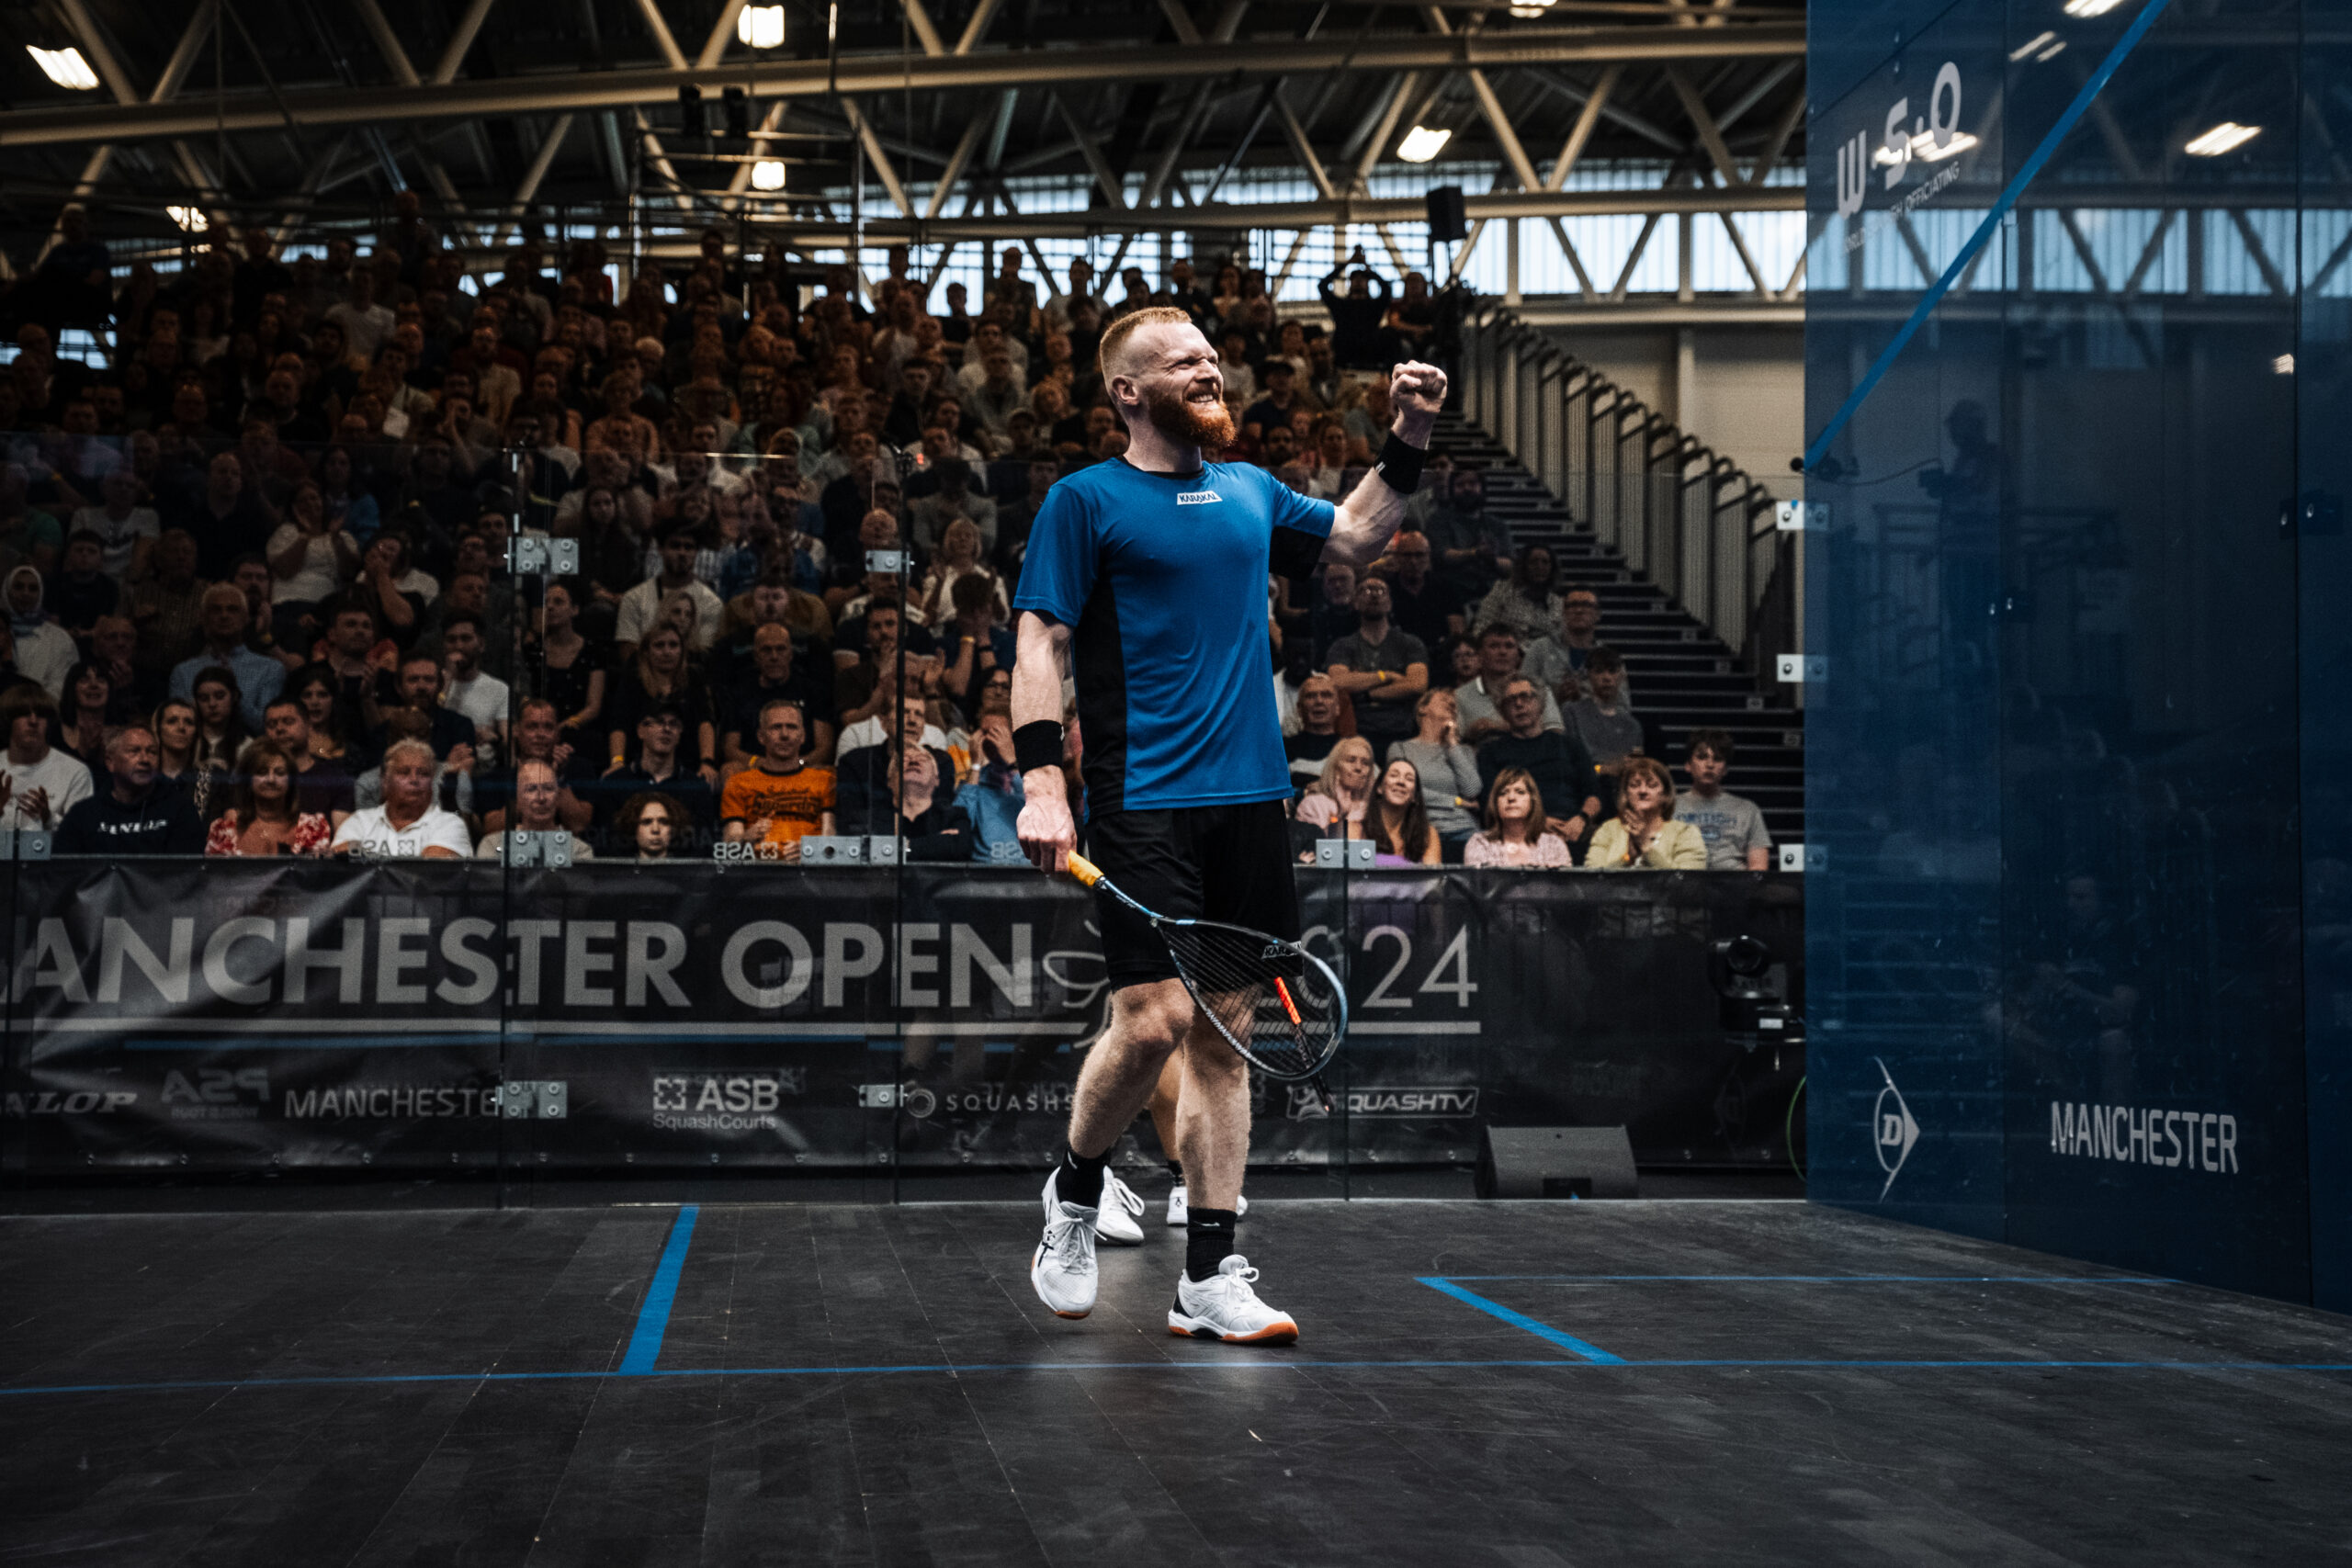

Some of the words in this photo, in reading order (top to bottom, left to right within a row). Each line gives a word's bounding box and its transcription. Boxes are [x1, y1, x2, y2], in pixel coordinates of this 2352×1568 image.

[0, 917, 692, 1007] ANCHESTER
[721, 919, 1032, 1009] OPEN
[285, 1089, 502, 1118] MANCHESTE
[695, 1078, 779, 1112] ASB
[1332, 1093, 1472, 1112] QUASHTV
[653, 1112, 775, 1132] SquashCourts
[2050, 1101, 2239, 1175] MANCHESTER
